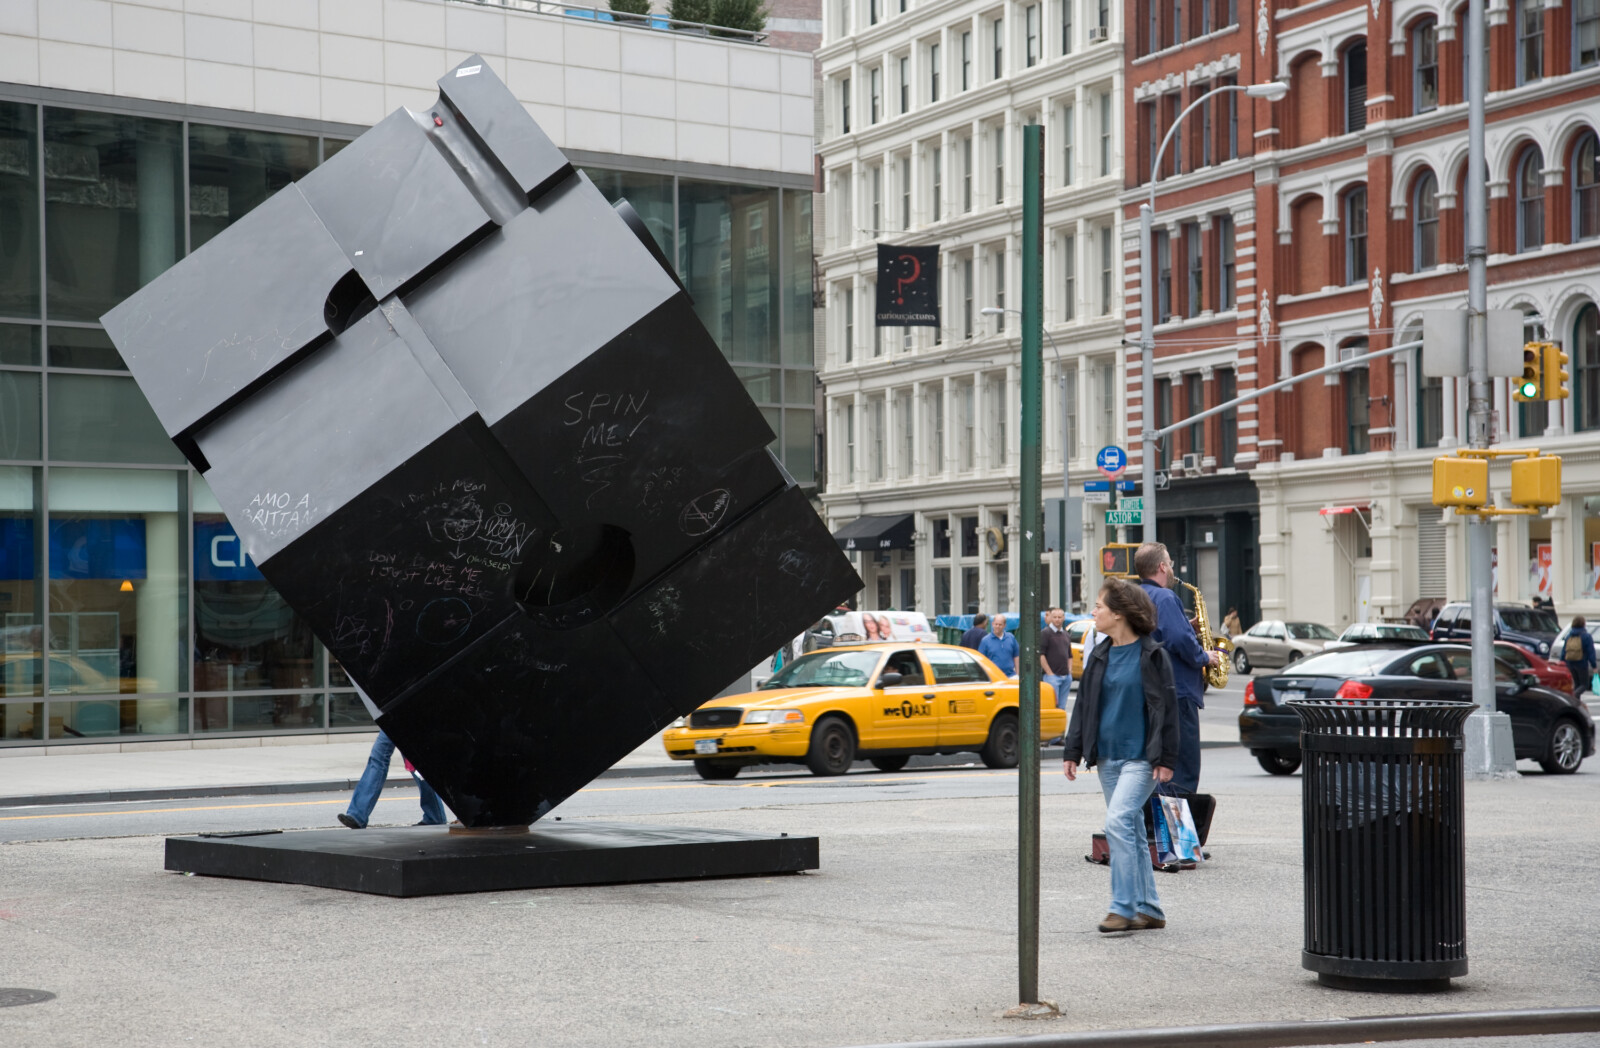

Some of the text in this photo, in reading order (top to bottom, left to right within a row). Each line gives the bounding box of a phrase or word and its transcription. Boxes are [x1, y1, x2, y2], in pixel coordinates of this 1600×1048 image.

[564, 391, 649, 426] SPIN
[582, 415, 649, 448] ME!
[249, 491, 309, 509] AMO A
[1108, 511, 1132, 523] ASTOR
